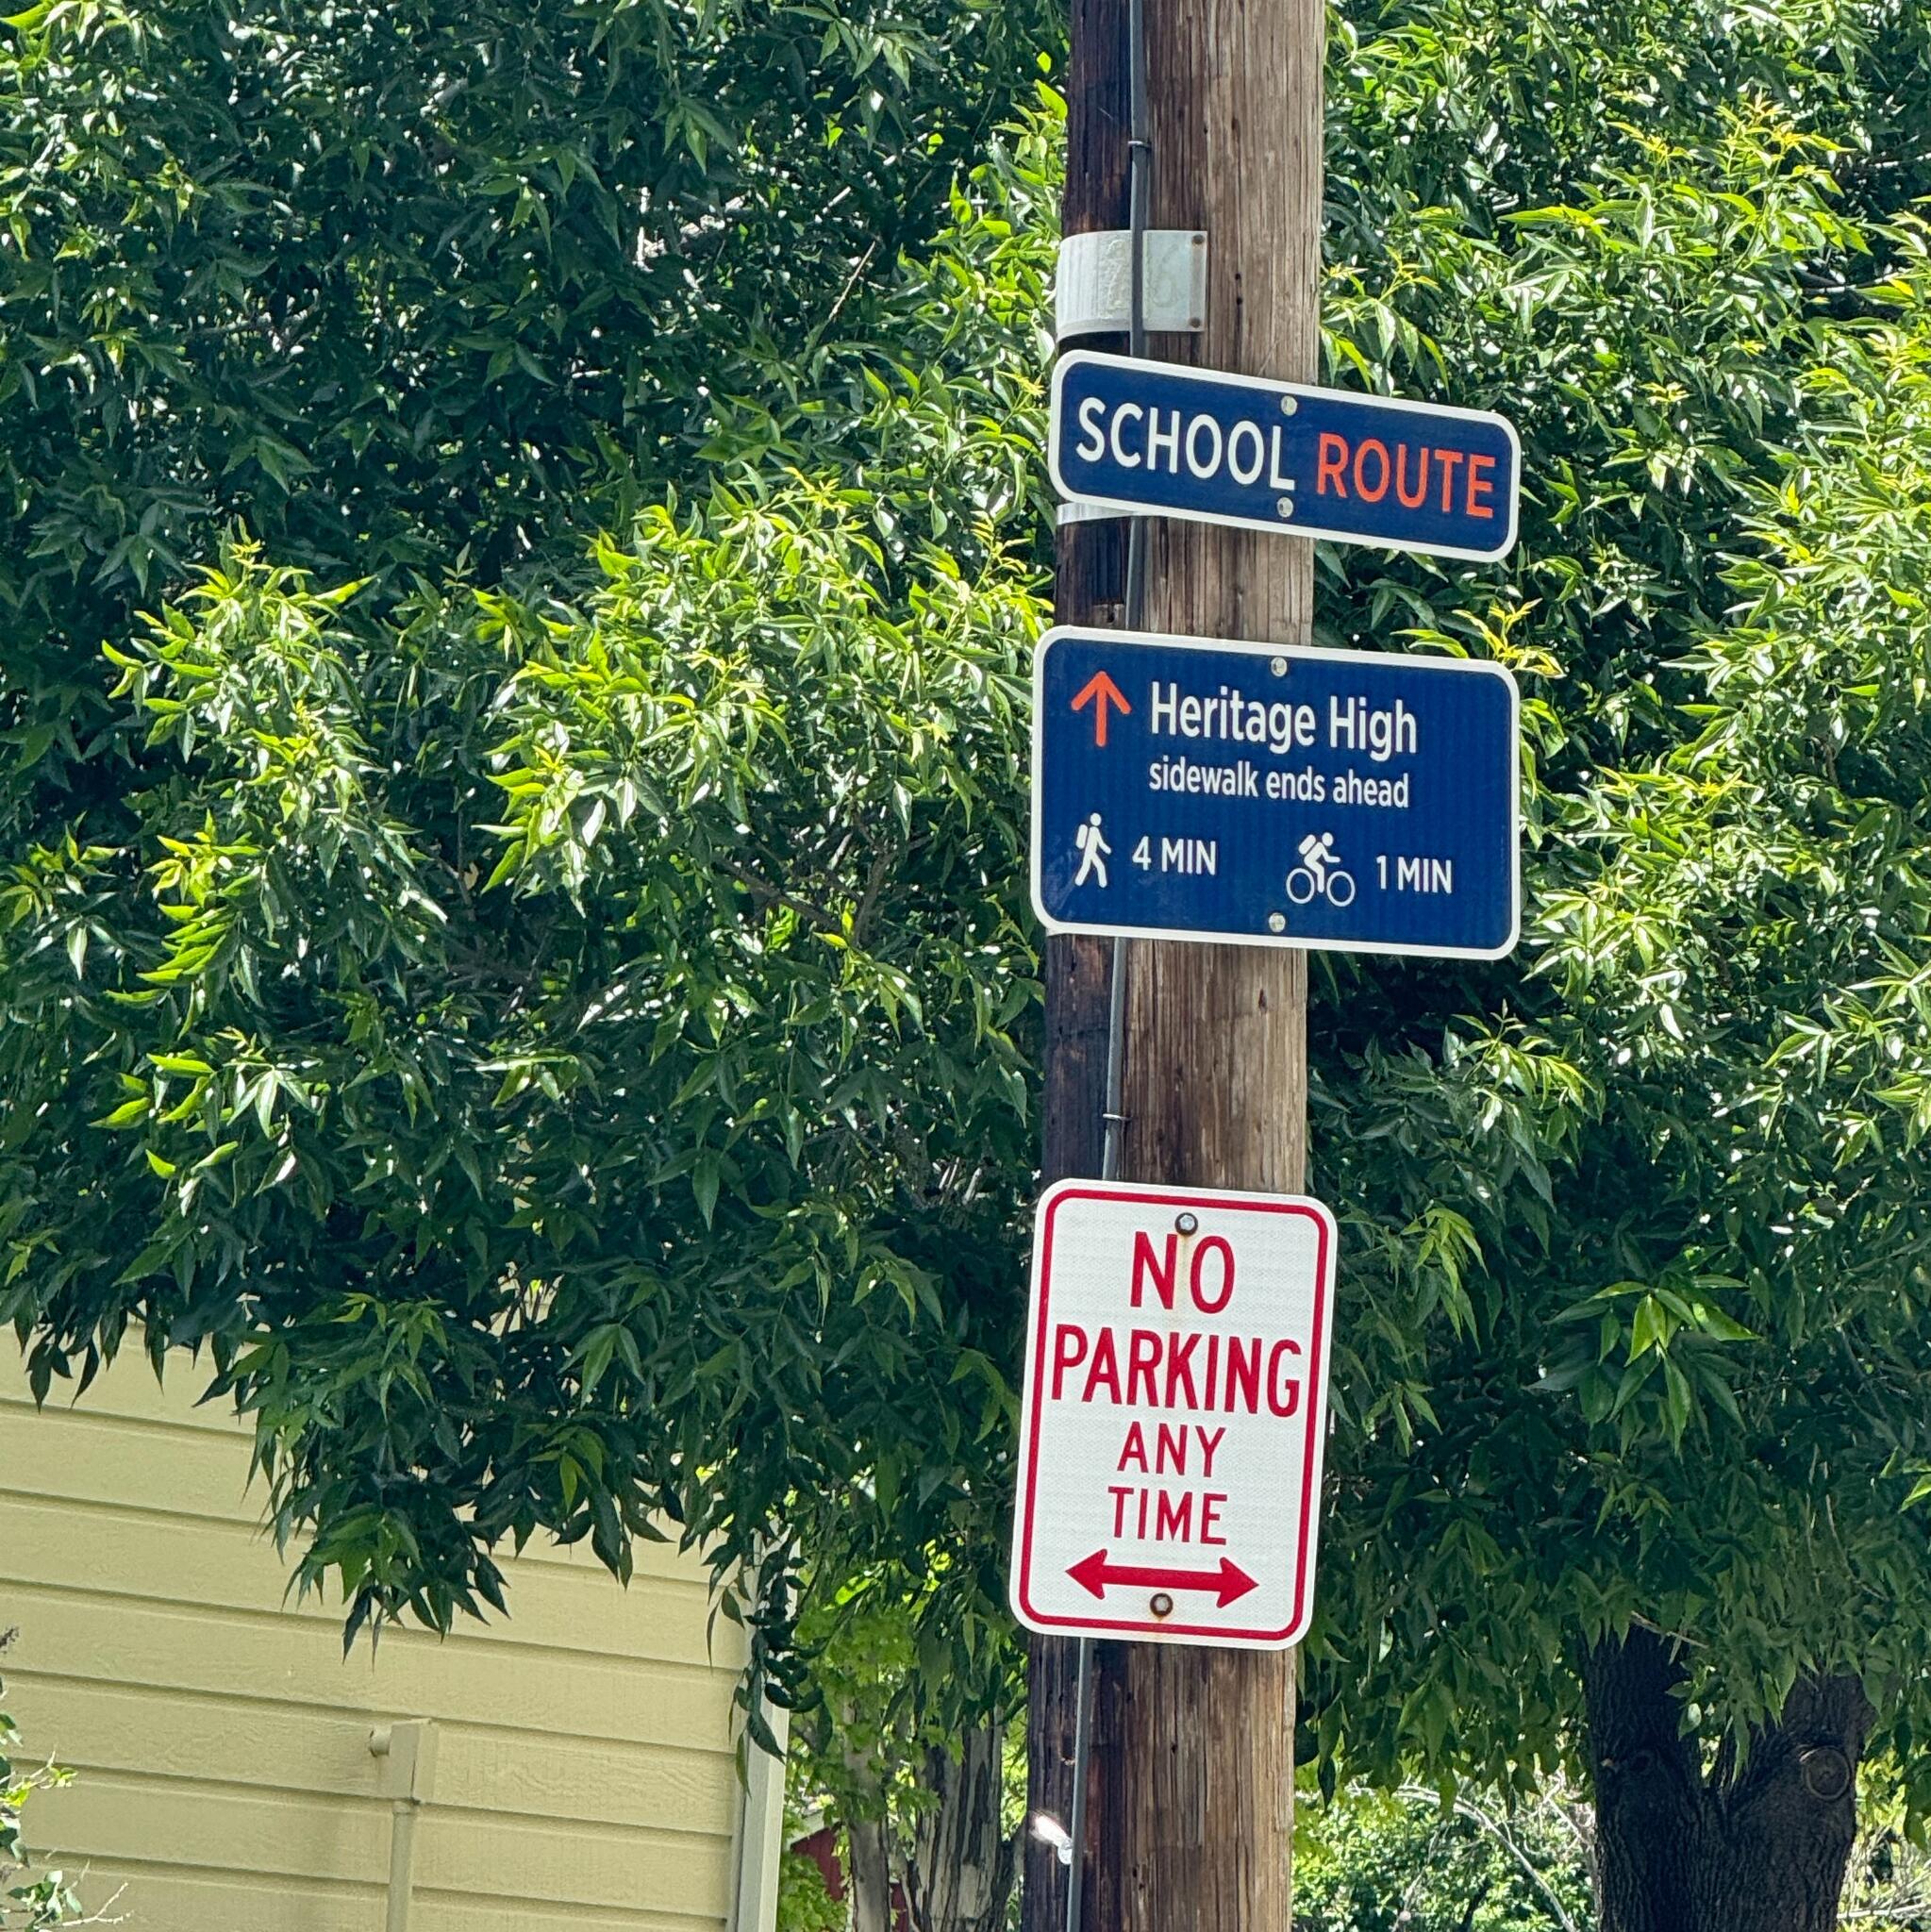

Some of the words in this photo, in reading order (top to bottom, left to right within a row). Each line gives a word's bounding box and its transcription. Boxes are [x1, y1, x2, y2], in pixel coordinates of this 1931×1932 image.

[1075, 396, 1295, 491] SCHOOL
[1317, 432, 1496, 519] ROUTE
[1151, 680, 1316, 755] Heritage
[1328, 695, 1418, 762] High
[1148, 755, 1258, 798] sidewalk
[1265, 765, 1325, 803] ends
[1332, 769, 1409, 808] ahead
[1132, 835, 1151, 872] 4
[1161, 837, 1217, 875] MIN
[1376, 855, 1389, 891] 1
[1397, 858, 1453, 894] MIN
[1130, 1231, 1234, 1314] NO
[1051, 1324, 1301, 1417] PARKING
[1117, 1421, 1226, 1477] ANY
[1108, 1486, 1227, 1545] TIME
